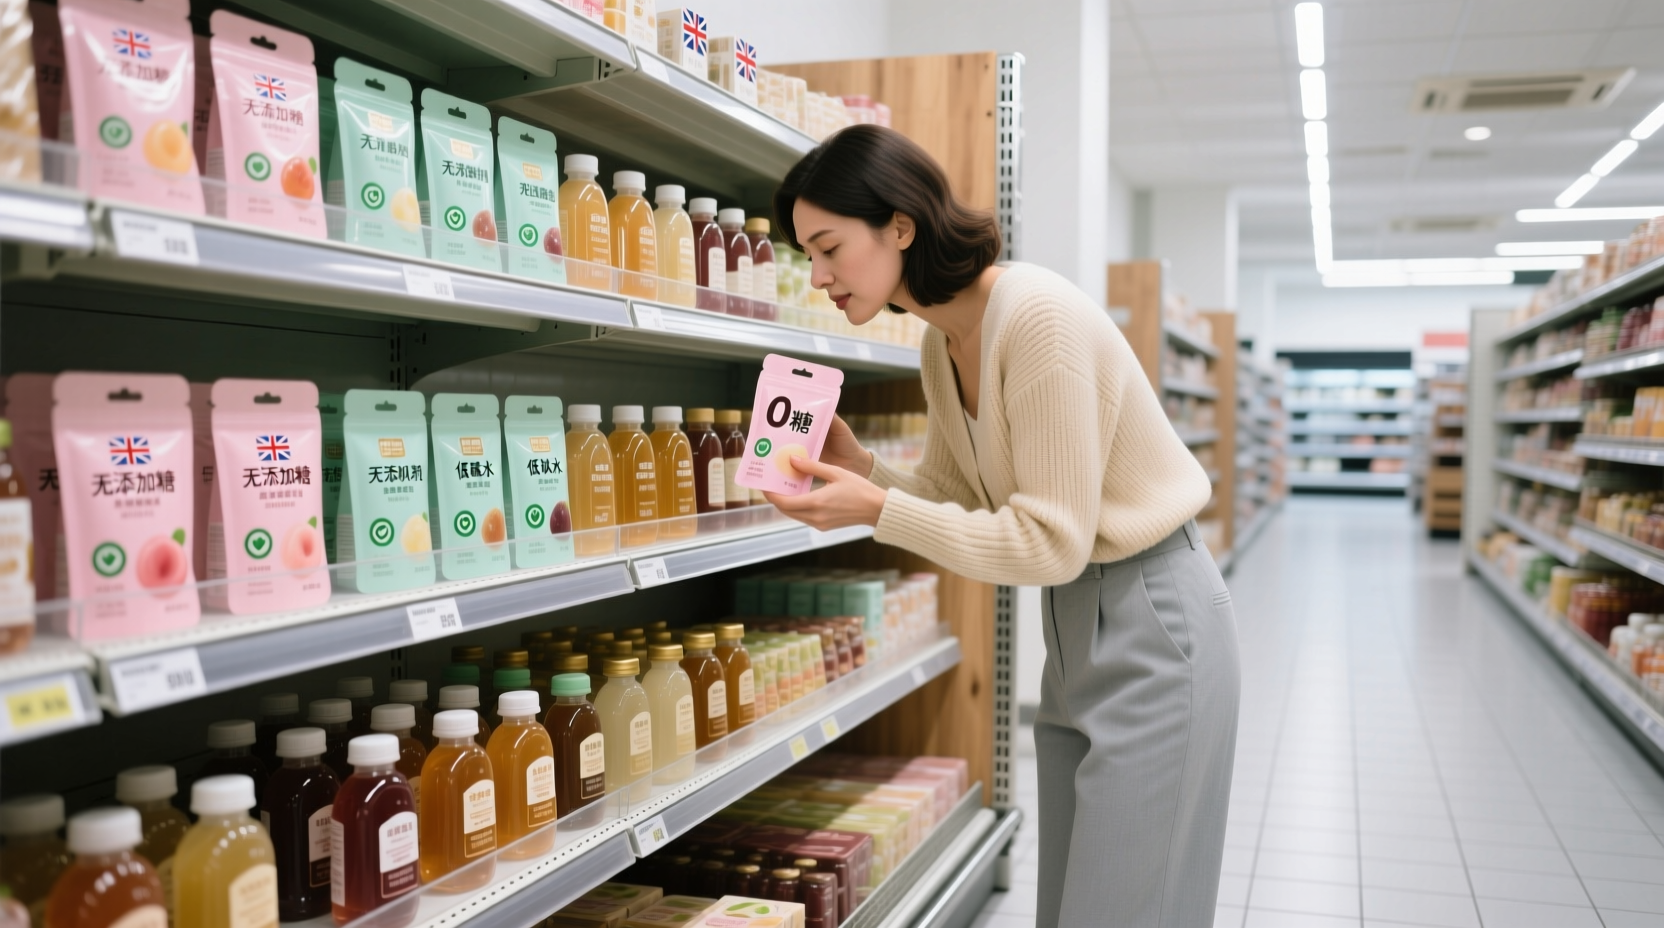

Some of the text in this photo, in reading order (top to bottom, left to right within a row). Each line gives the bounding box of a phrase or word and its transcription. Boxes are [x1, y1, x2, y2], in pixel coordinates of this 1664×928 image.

[97, 60, 170, 83] 添加糖
[241, 98, 304, 127] 无添加糖
[766, 396, 814, 434] 0糖
[92, 470, 175, 497] 无添加糖
[242, 465, 311, 488] 无添加糖
